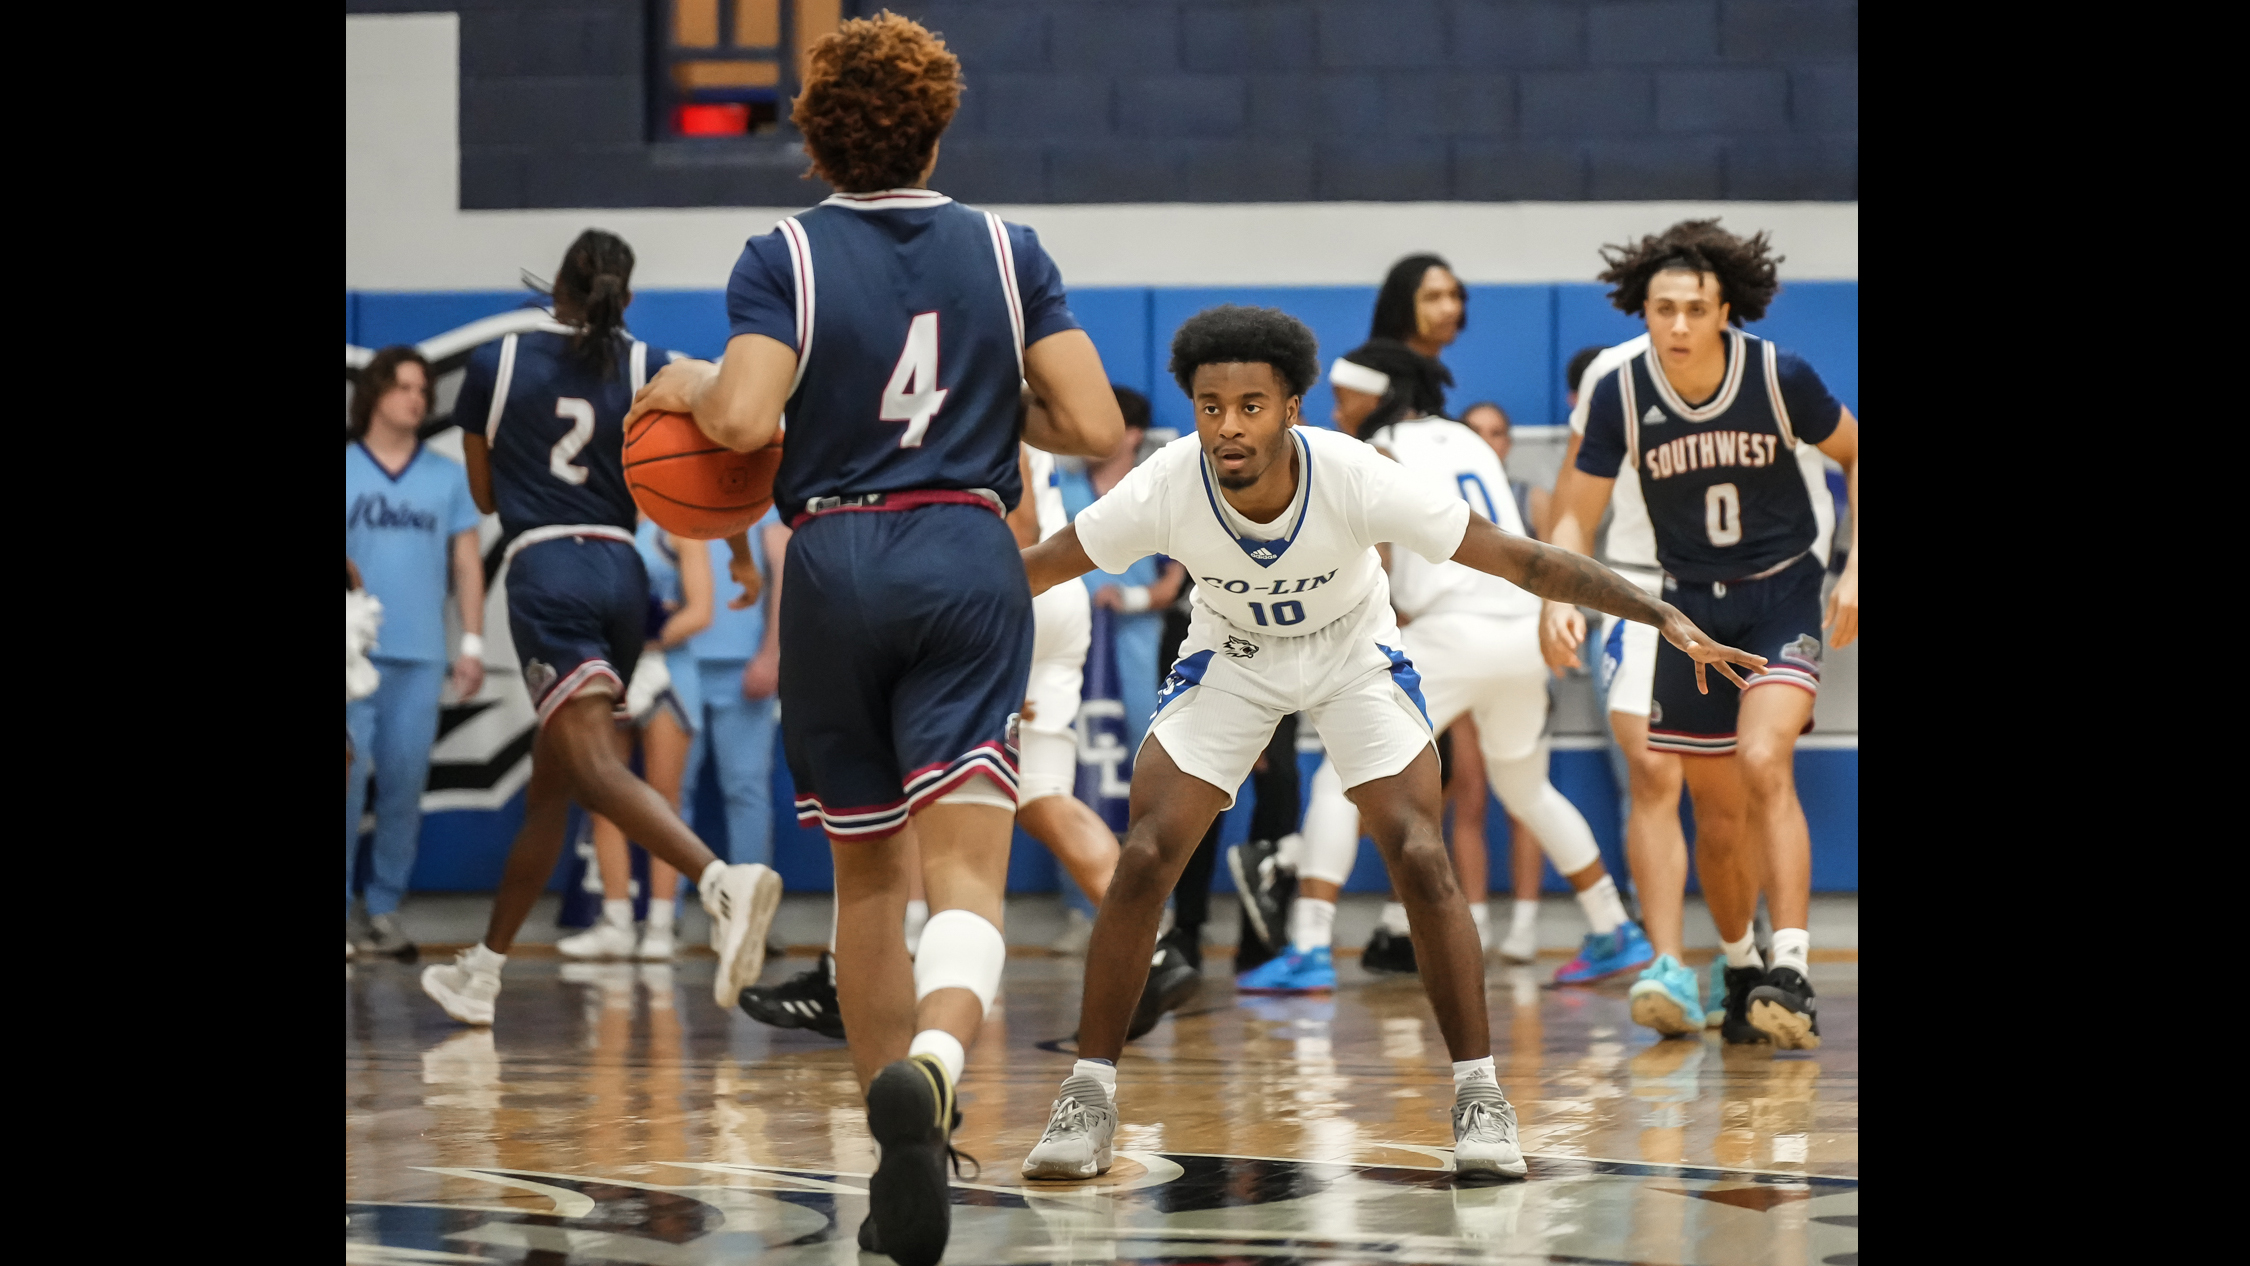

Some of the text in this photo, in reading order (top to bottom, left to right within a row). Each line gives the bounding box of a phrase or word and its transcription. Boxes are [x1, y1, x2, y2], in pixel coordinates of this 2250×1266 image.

[879, 311, 949, 449] 4
[550, 396, 596, 486] 2
[1645, 430, 1777, 480] SOUTHWEST
[1705, 482, 1742, 547] 0
[1201, 568, 1339, 595] CO-LIN
[1247, 600, 1306, 626] 10
